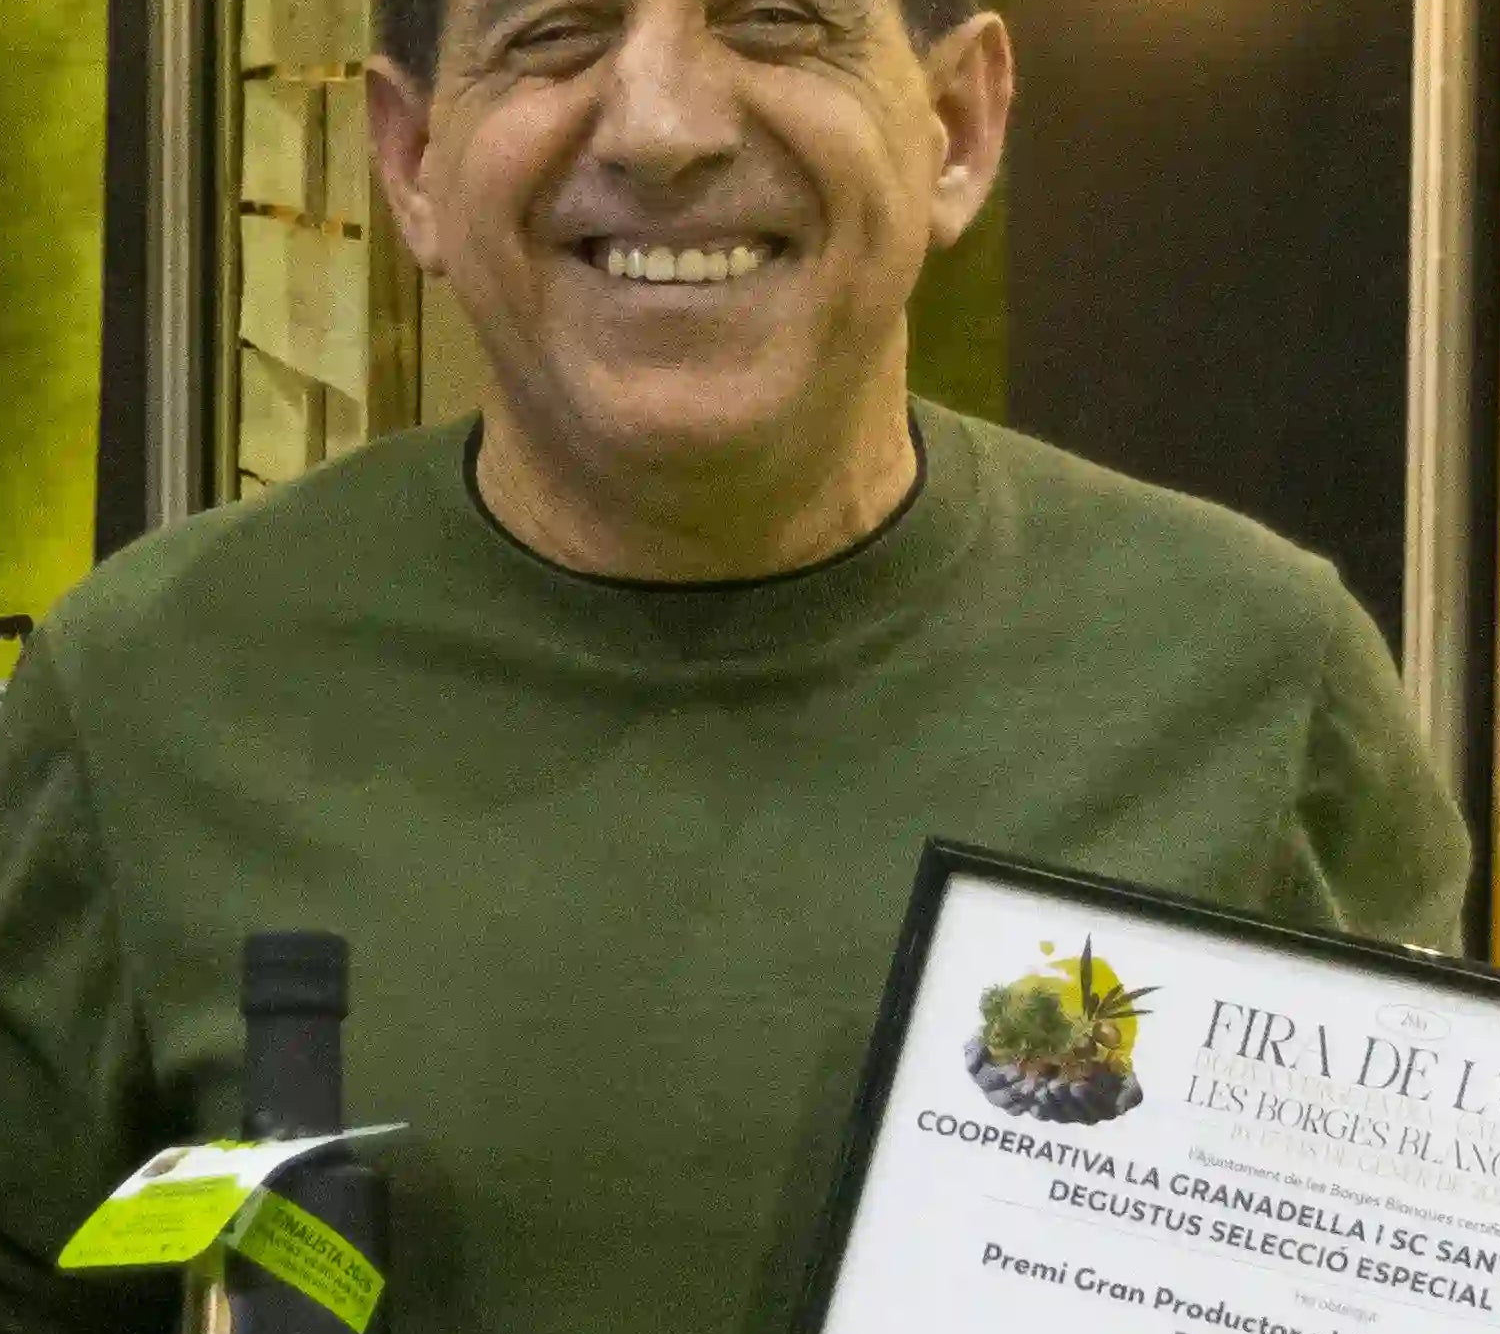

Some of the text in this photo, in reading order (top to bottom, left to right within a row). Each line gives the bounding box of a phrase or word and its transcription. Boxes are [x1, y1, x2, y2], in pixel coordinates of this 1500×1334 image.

[1201, 998, 1331, 1079] FIRA
[1355, 1035, 1438, 1101] DE
[1183, 1073, 1249, 1115] LES
[1253, 1090, 1391, 1150] BORGES
[916, 1109, 1116, 1179] COOPERATIVA
[1123, 1160, 1160, 1190] LA
[1168, 1172, 1366, 1242] GRANADELLA
[1388, 1227, 1428, 1256] SC
[1186, 1146, 1282, 1185] l'Ajuntament
[1285, 1170, 1304, 1187] de
[1305, 1175, 1328, 1193] les
[1328, 1182, 1381, 1210] Borges
[1382, 1195, 1454, 1228] Blanques
[980, 1241, 1068, 1285] Premi
[1073, 1266, 1145, 1305] Gran
[1047, 1178, 1203, 1236] DEGUSTUS
[1208, 1219, 1349, 1273] SELECCIÓ
[1355, 1255, 1492, 1311] ESPECIAL
